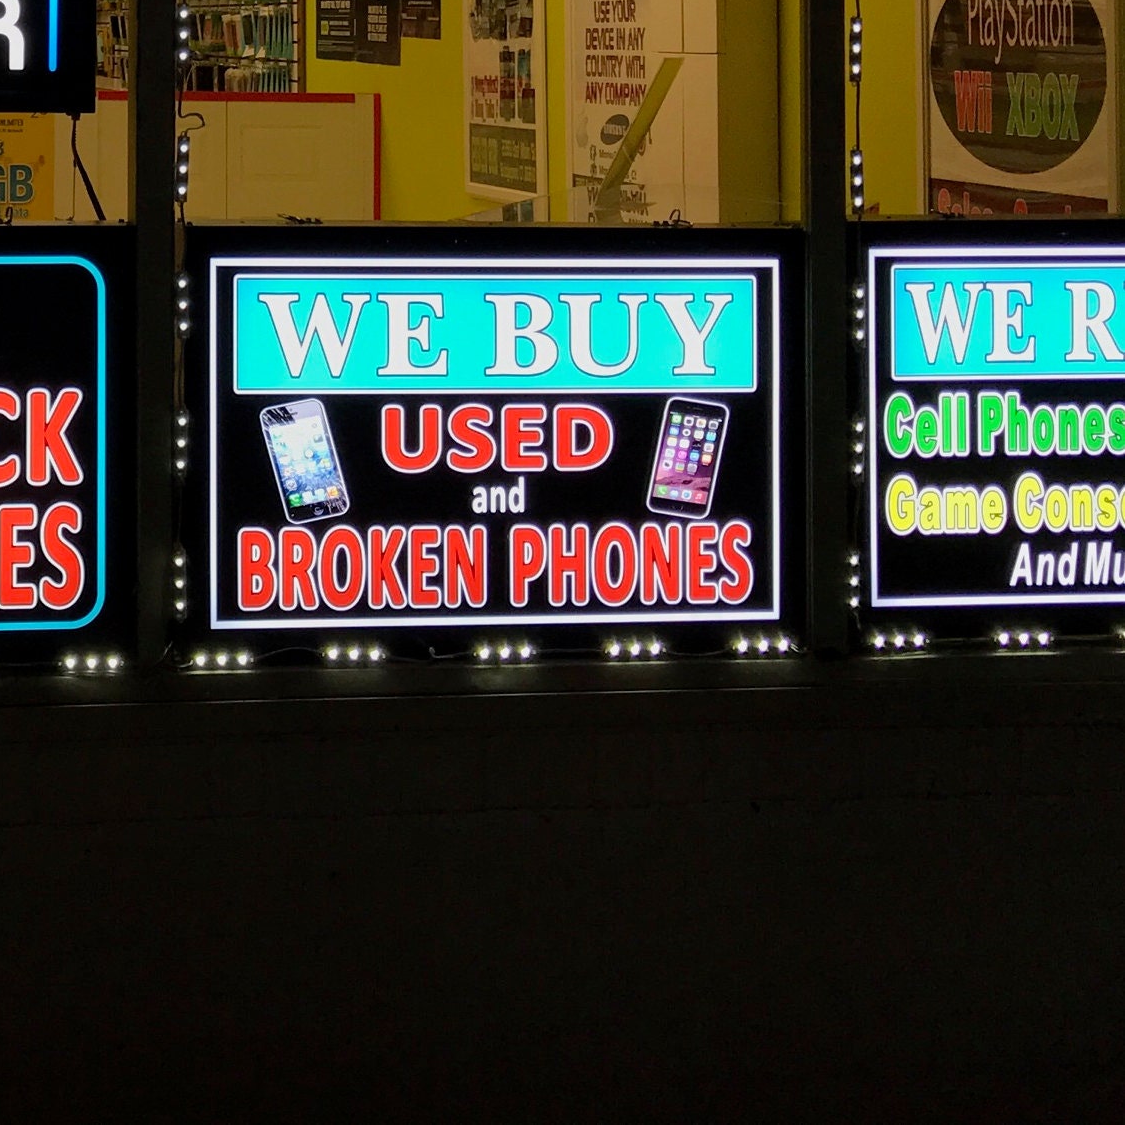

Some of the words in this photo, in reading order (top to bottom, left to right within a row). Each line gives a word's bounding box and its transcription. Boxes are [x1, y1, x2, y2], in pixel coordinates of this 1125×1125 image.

[585, 27, 615, 51] DEVICE
[616, 27, 626, 50] IN
[627, 27, 646, 51] ANY
[593, 0, 610, 23] USE
[612, 0, 636, 23] YOUR
[584, 81, 604, 104] ANY
[605, 82, 647, 107] COMPANY
[585, 54, 624, 78] COUNTRY
[625, 55, 646, 79] WITH
[954, 71, 993, 135] Wii
[1006, 73, 1080, 141] XBOX
[257, 292, 449, 378] WE
[484, 292, 734, 377] BUY
[905, 280, 1036, 365] WE
[381, 402, 615, 474] USED
[883, 390, 970, 458] Cell
[977, 390, 1125, 457] Phones
[471, 476, 526, 514] and
[886, 472, 1008, 537] Game
[236, 523, 488, 612] BROKEN
[509, 521, 754, 608] PHONES
[1010, 542, 1079, 587] And
